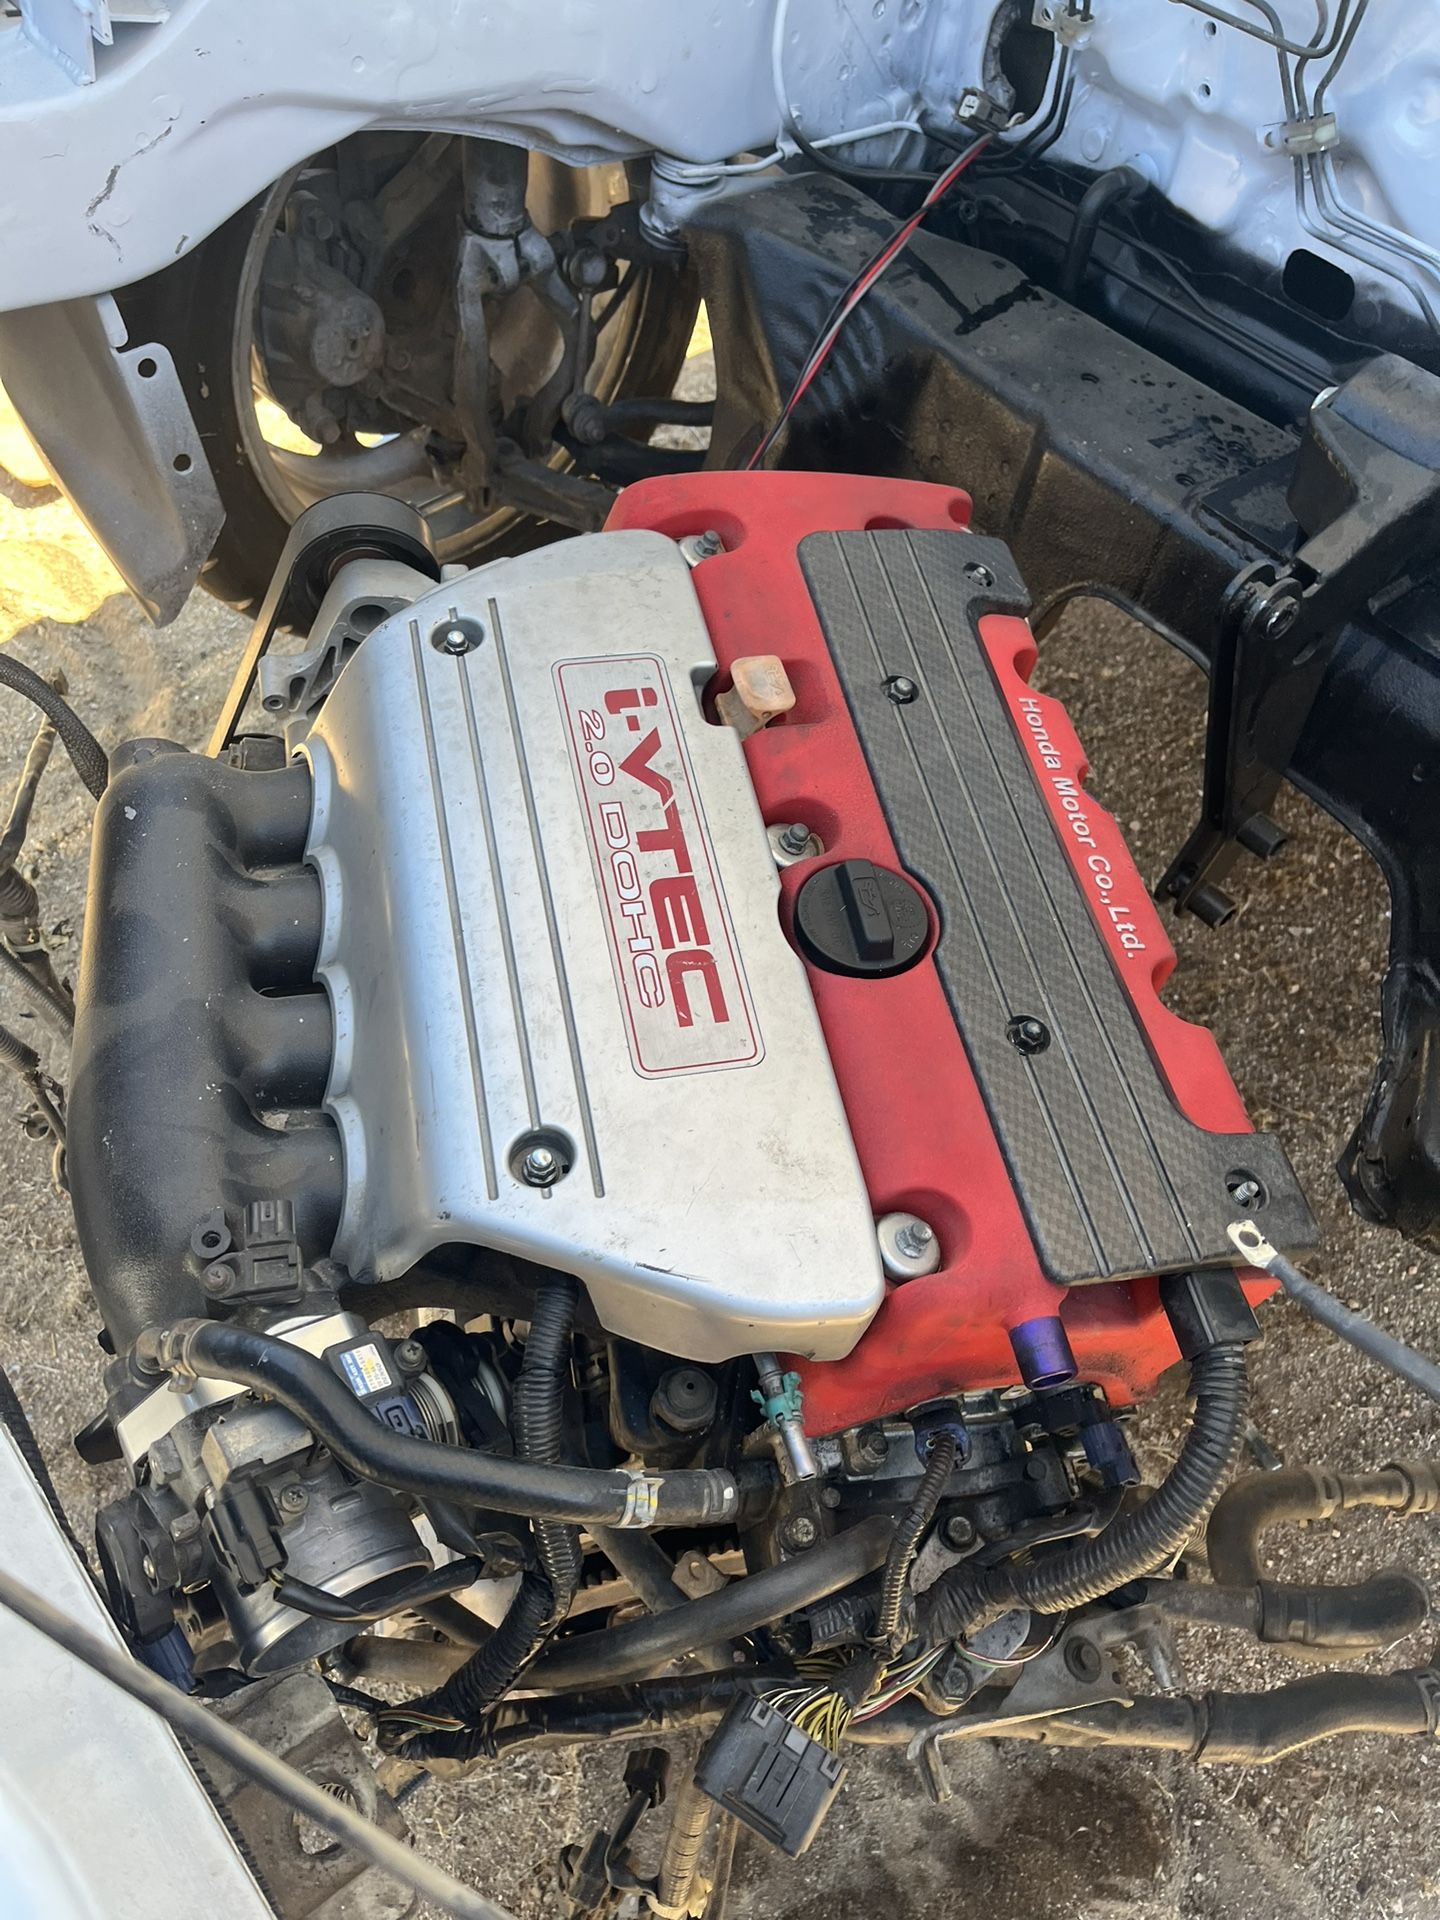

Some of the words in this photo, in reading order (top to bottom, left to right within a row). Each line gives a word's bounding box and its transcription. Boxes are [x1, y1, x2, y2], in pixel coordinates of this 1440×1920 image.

[578, 709, 616, 787] 2.0
[599, 801, 665, 1009] DOHC
[604, 687, 730, 1028] i-VTEC
[1018, 697, 1061, 769] Honda
[1052, 776, 1097, 848] Motor
